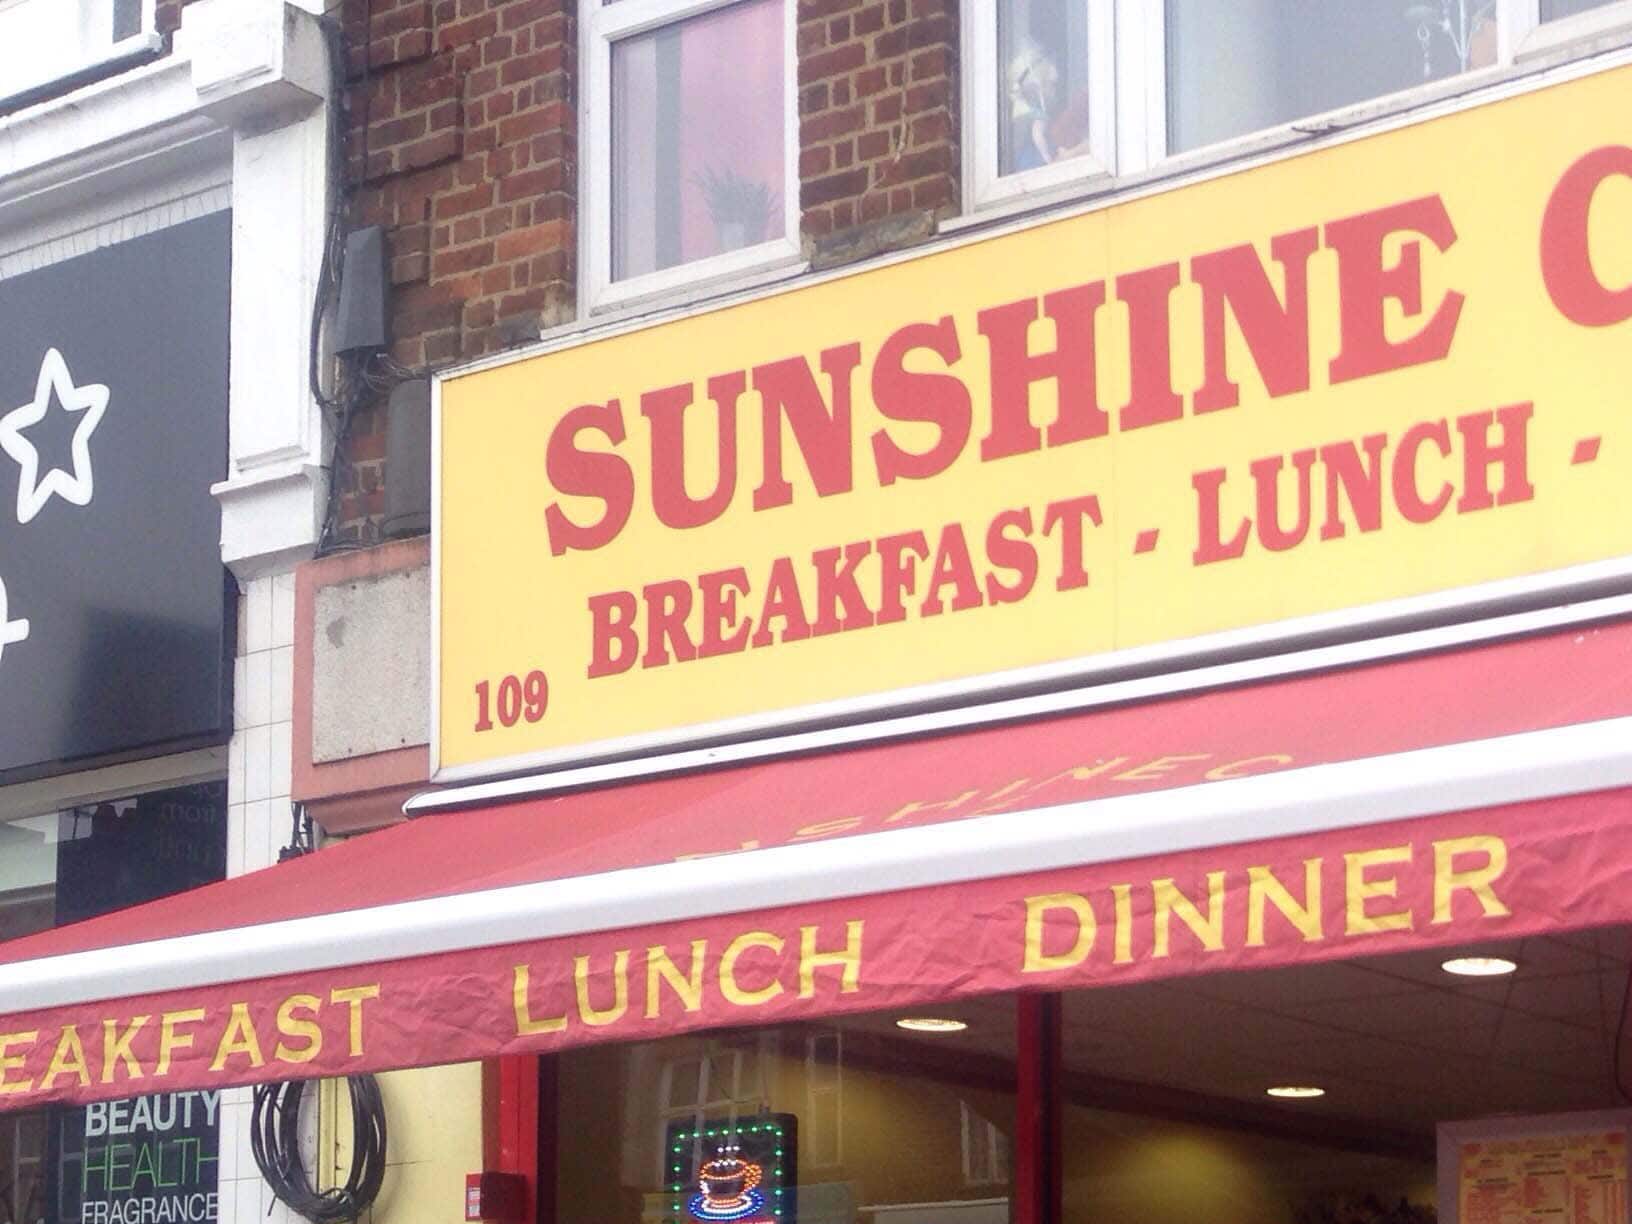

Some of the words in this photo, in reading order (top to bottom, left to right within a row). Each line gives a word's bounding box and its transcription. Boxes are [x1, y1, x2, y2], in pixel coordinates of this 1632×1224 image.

[544, 193, 1466, 557] SUNSHINE
[586, 494, 1104, 680] BREAKFAST
[1191, 402, 1535, 567] LUNCH
[473, 670, 550, 733] 109
[511, 918, 866, 1038] LUNCH
[1021, 834, 1512, 973] DINNER
[84, 1089, 221, 1137] BEAUTY
